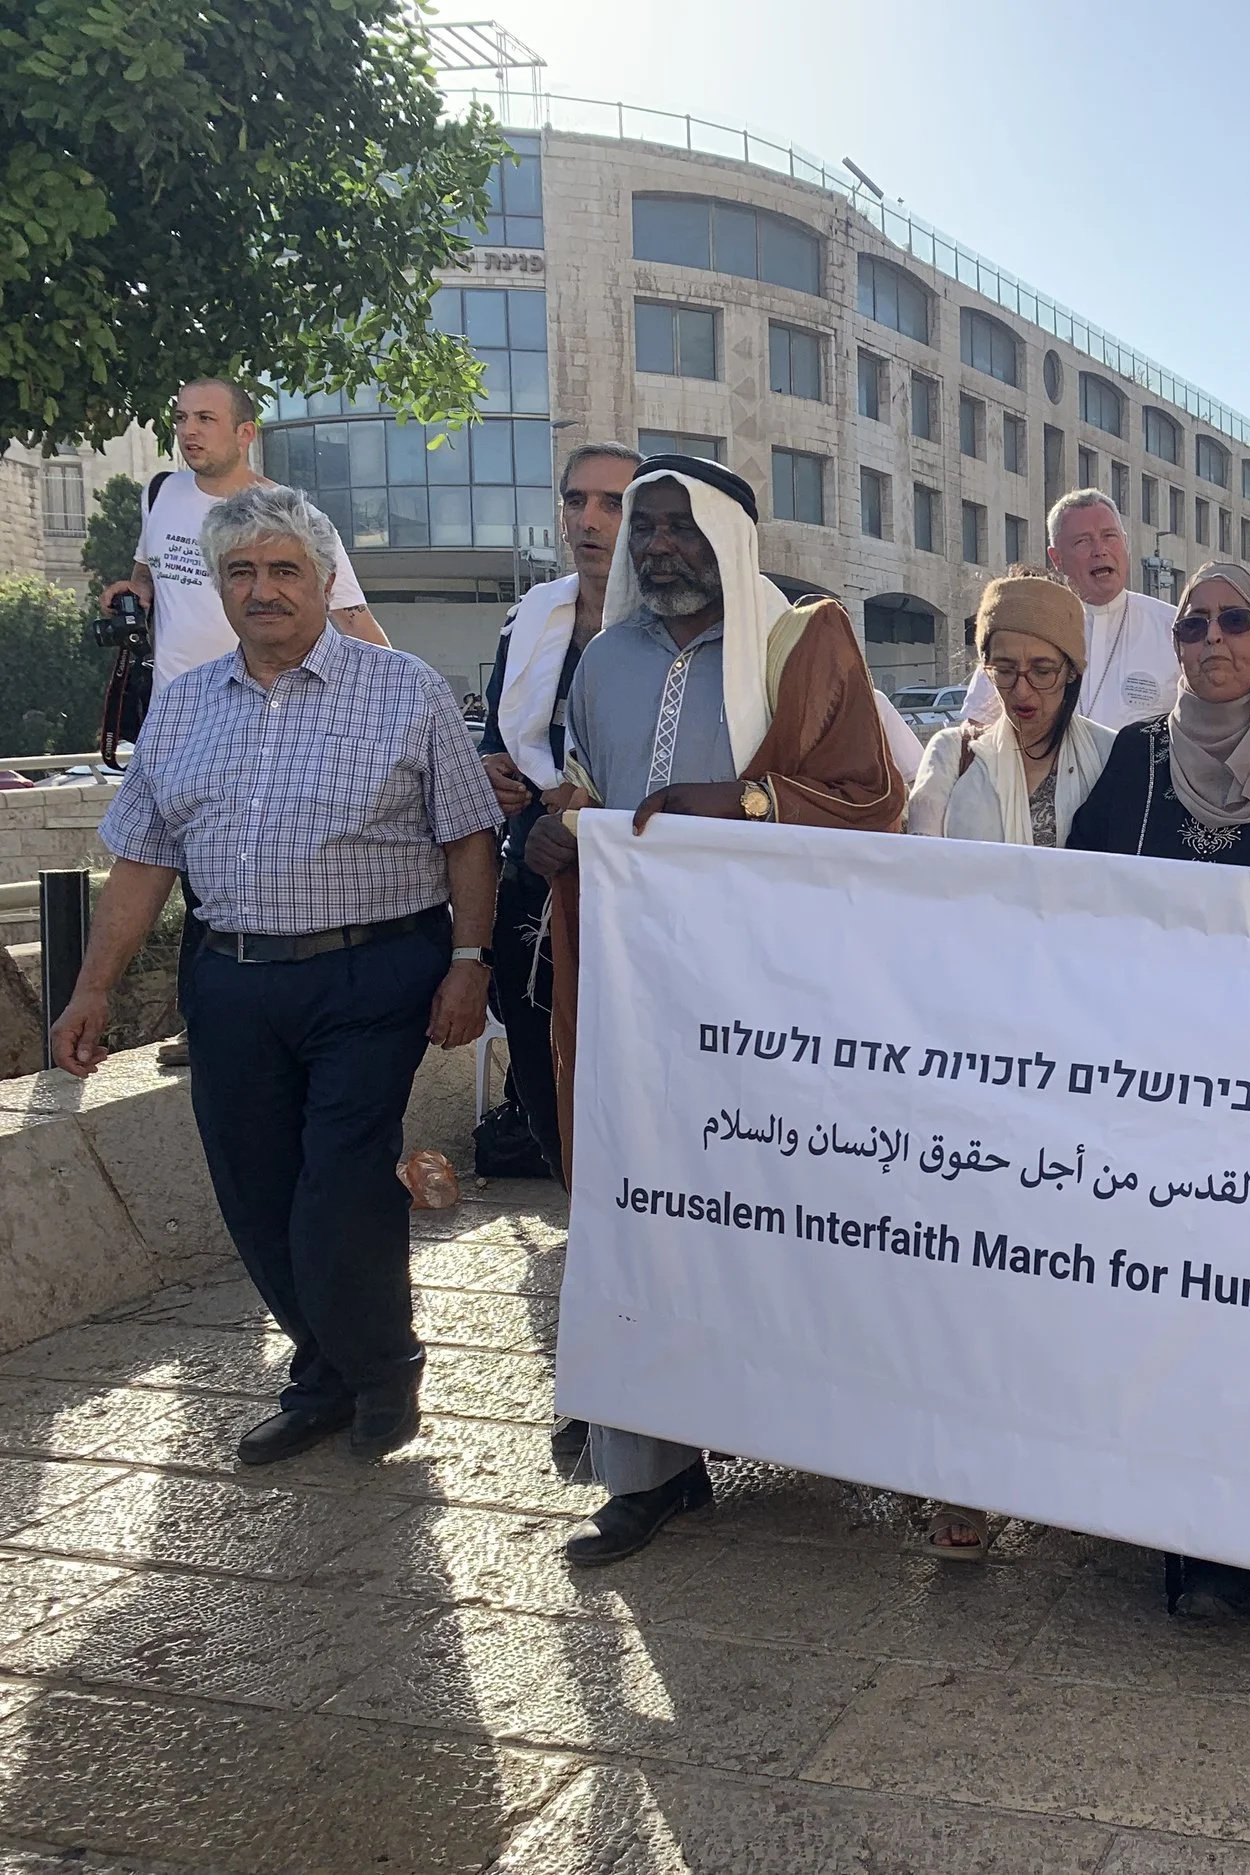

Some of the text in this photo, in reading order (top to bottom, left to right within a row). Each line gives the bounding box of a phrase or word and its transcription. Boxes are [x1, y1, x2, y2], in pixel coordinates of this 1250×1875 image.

[484, 252, 544, 273] פנינת
[165, 562, 194, 574] HUMAN
[117, 649, 128, 677] Canon
[105, 732, 114, 760] Canon
[700, 1020, 820, 1064] ולשלום
[834, 1039, 911, 1073] אדם
[919, 1049, 1056, 1089] לזכויות
[704, 1109, 798, 1156] والسلام
[808, 1123, 909, 1174] الإنسان
[920, 1135, 1010, 1180] حقوق
[1021, 1144, 1085, 1190] أجل
[1093, 1166, 1137, 1199] من
[616, 1178, 784, 1234] Jerusalem
[796, 1205, 959, 1263] Interfaith
[973, 1231, 1094, 1283] March
[1109, 1249, 1168, 1293] for
